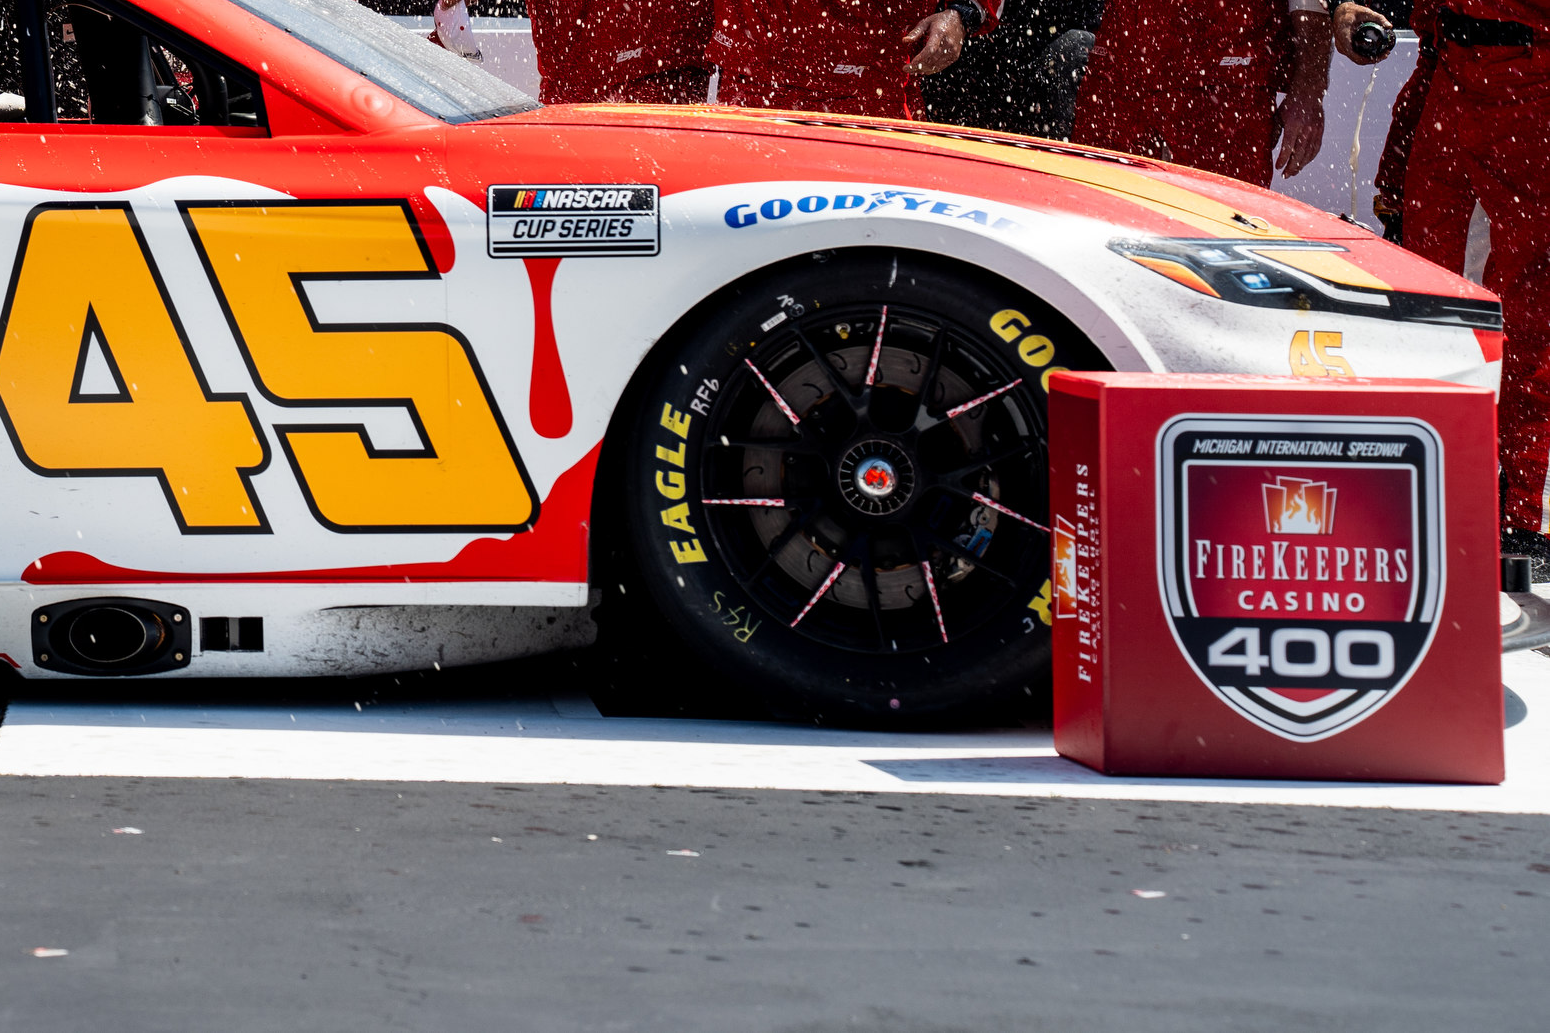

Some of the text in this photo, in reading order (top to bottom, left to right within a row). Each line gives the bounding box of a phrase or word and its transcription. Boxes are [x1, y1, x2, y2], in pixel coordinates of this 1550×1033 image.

[542, 190, 632, 208] NASCAR
[512, 218, 635, 239] CUP SERIES
[1288, 329, 1357, 378] 45
[1192, 438, 1407, 458] MICHIGAN INTERNATIONAL SPEEDWAY
[655, 402, 709, 565] EAGLE
[1075, 463, 1092, 684] FIREKEEPERS
[1237, 590, 1366, 614] CASINO
[1207, 626, 1396, 680] 400
